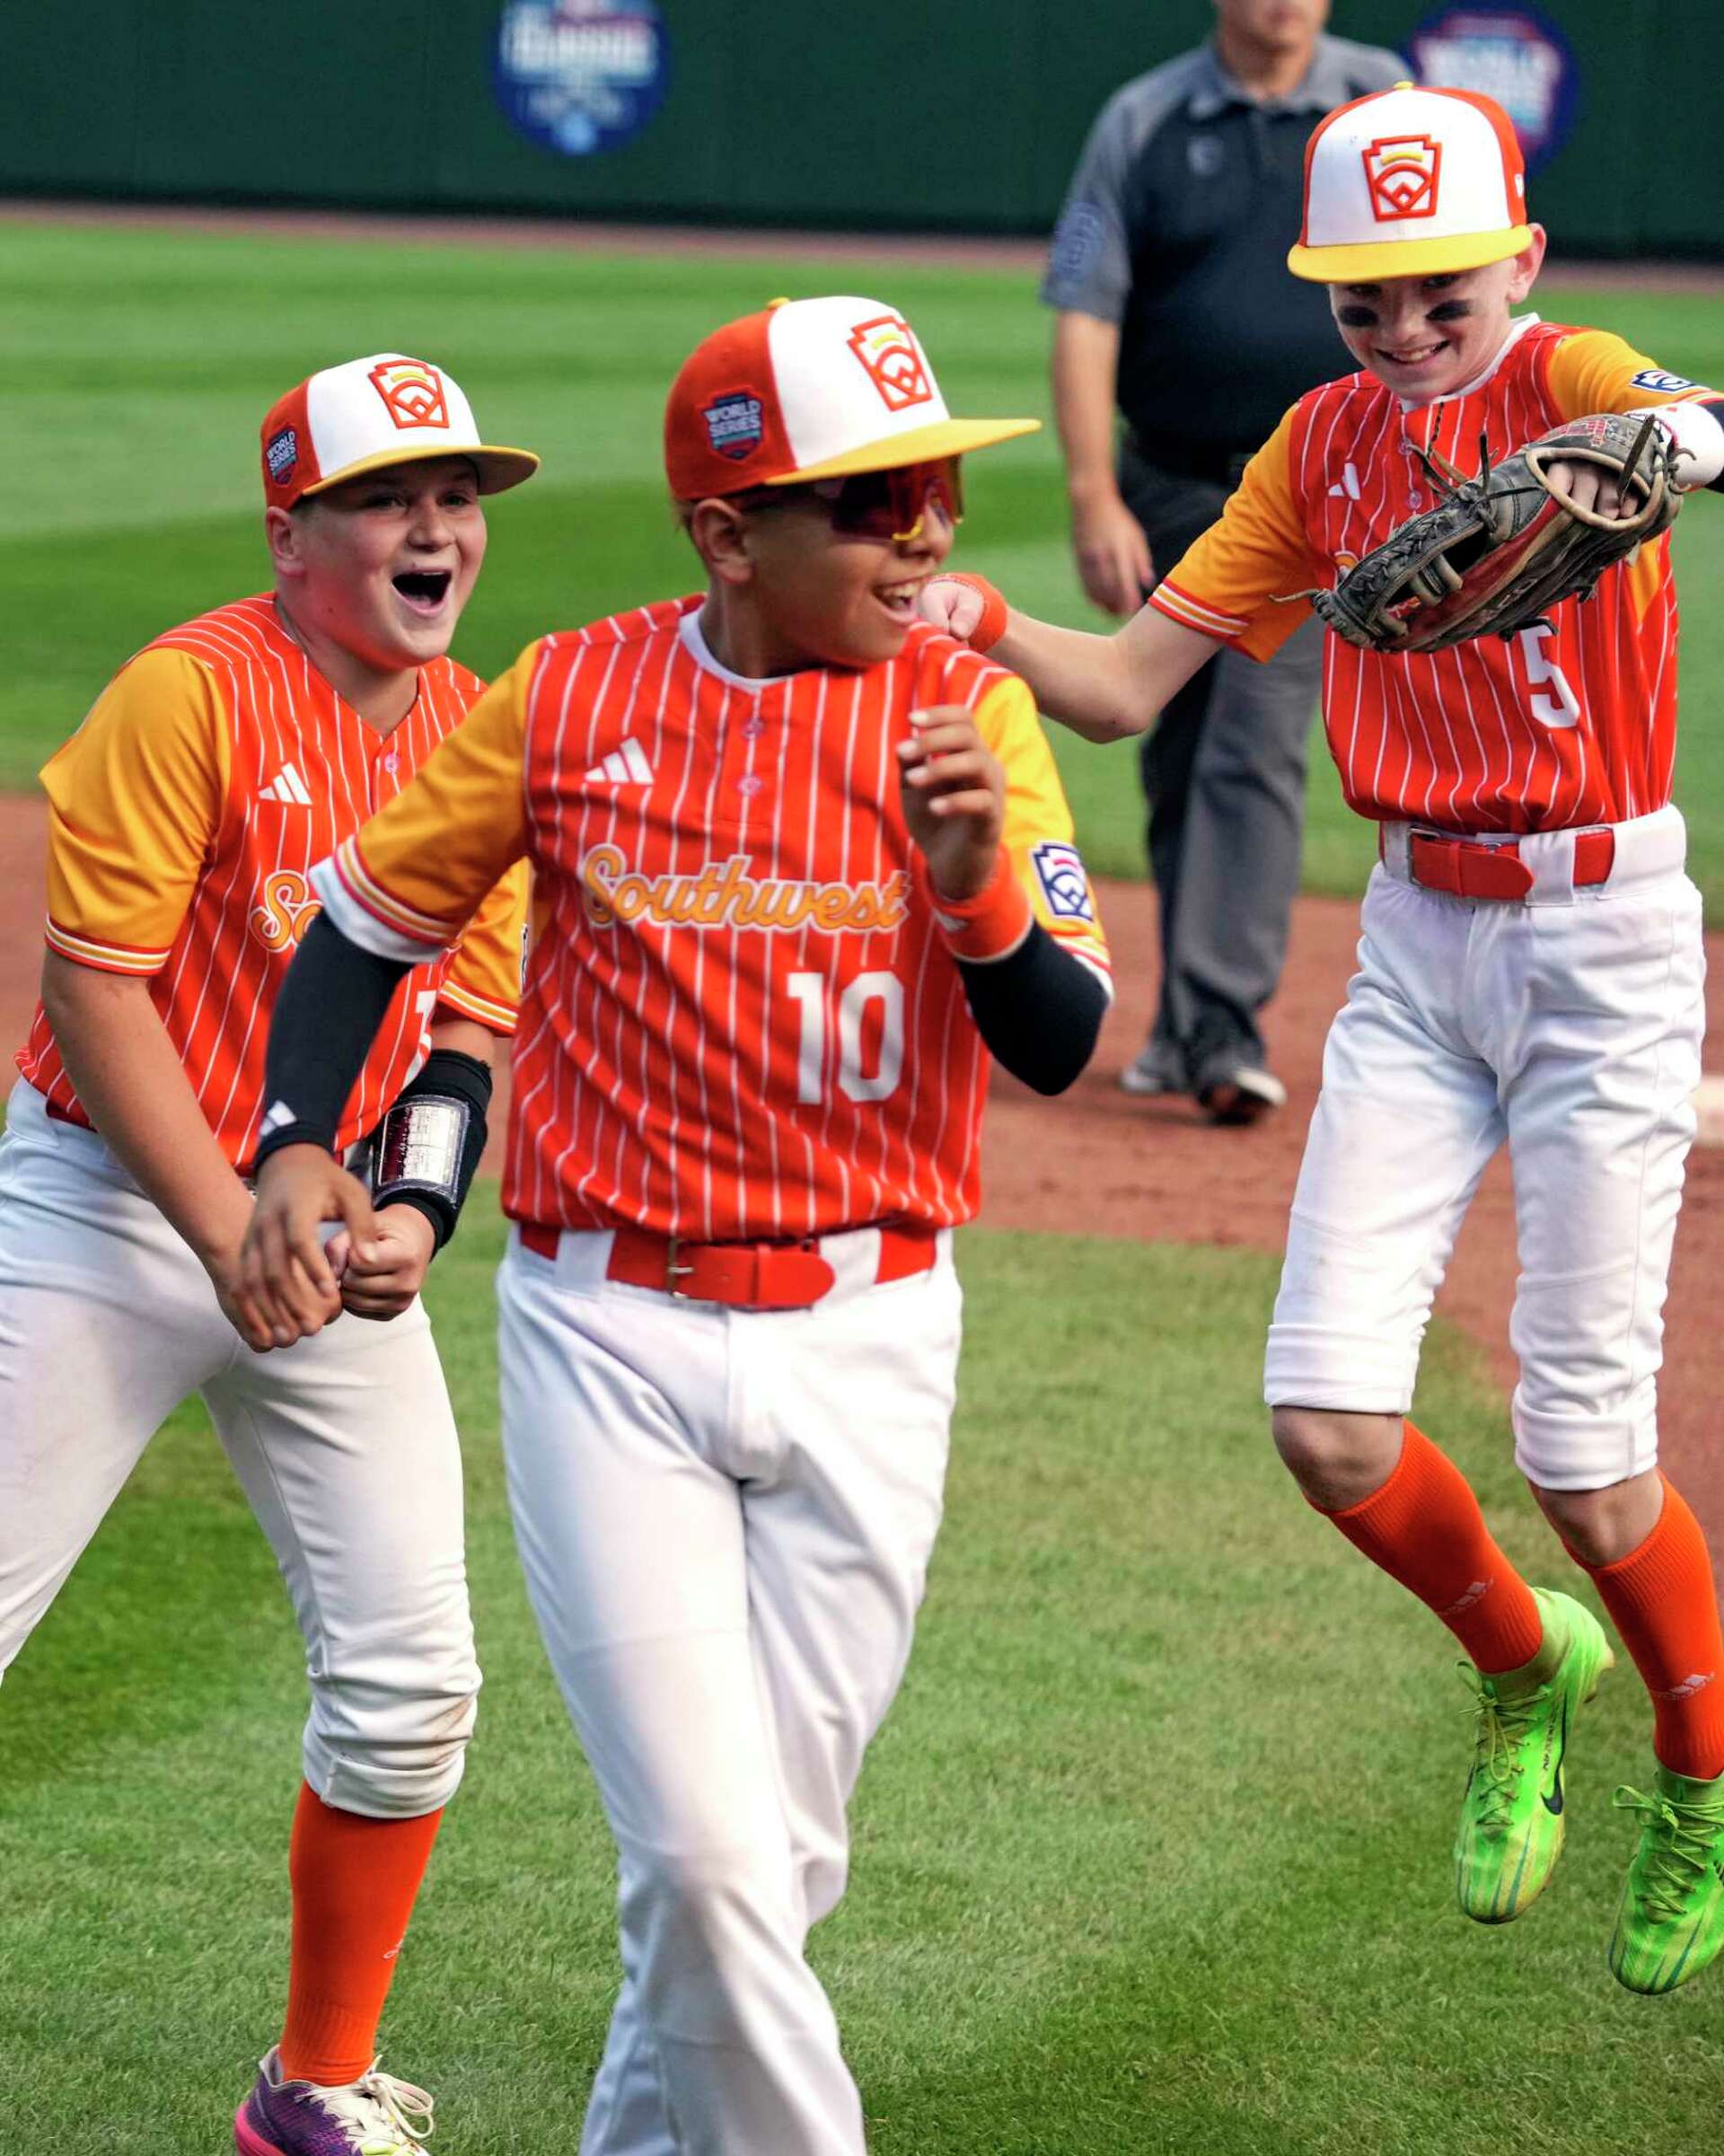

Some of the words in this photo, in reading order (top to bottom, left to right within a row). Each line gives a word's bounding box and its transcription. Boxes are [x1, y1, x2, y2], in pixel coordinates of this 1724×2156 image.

[703, 400, 761, 423] WORLD
[709, 414, 761, 438] SERIES
[1519, 624, 1580, 729] 5
[581, 842, 911, 936] Southwest
[787, 971, 905, 1105] 10
